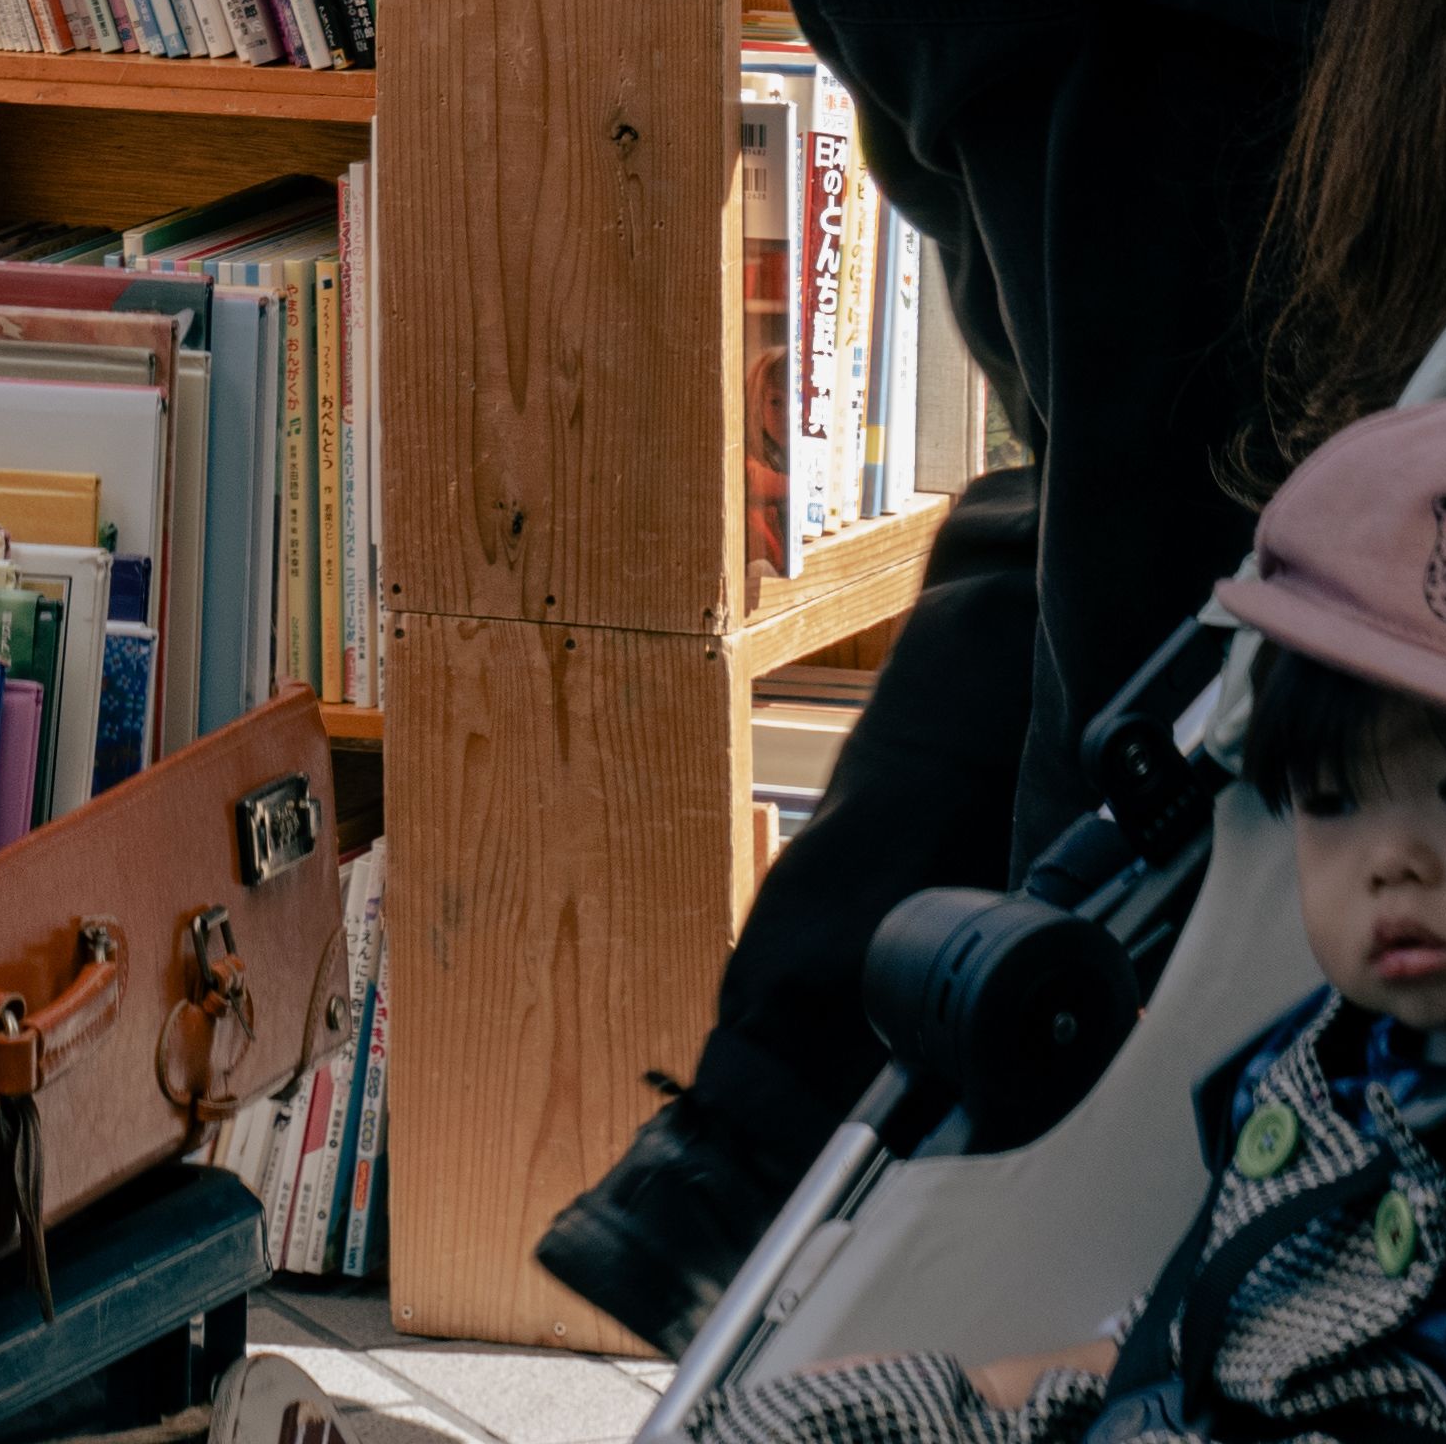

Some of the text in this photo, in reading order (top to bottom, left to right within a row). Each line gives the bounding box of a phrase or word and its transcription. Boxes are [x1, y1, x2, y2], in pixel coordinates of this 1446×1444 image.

[285, 283, 300, 412] やまの おんがくか
[319, 394, 335, 470] おべんとう
